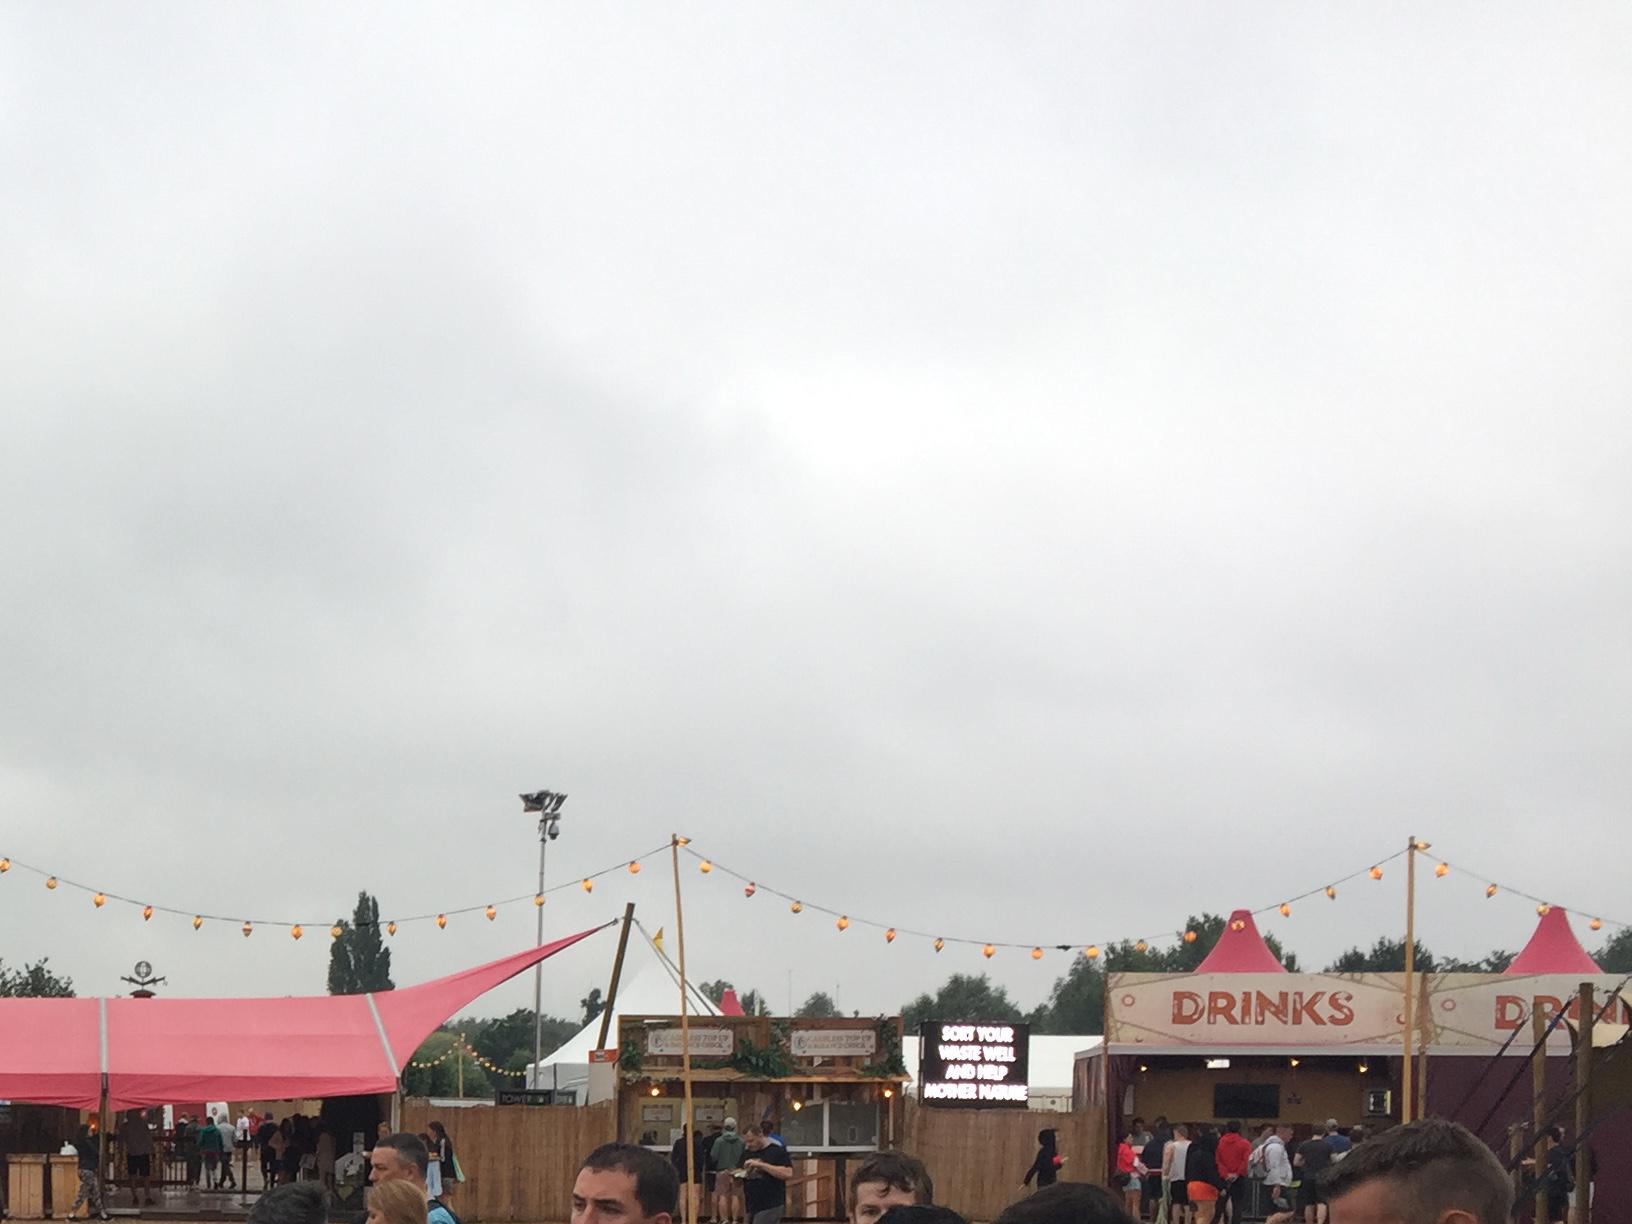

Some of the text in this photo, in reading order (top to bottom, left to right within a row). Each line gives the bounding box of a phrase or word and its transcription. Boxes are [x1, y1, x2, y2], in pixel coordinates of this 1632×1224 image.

[1171, 990, 1355, 1026] DRINKS
[941, 1025, 1014, 1042] SORT YOUR
[938, 1045, 1016, 1062] WASTE WELL
[945, 1064, 1008, 1081] AND HELP
[924, 1083, 1028, 1101] MOTHER NATURE
